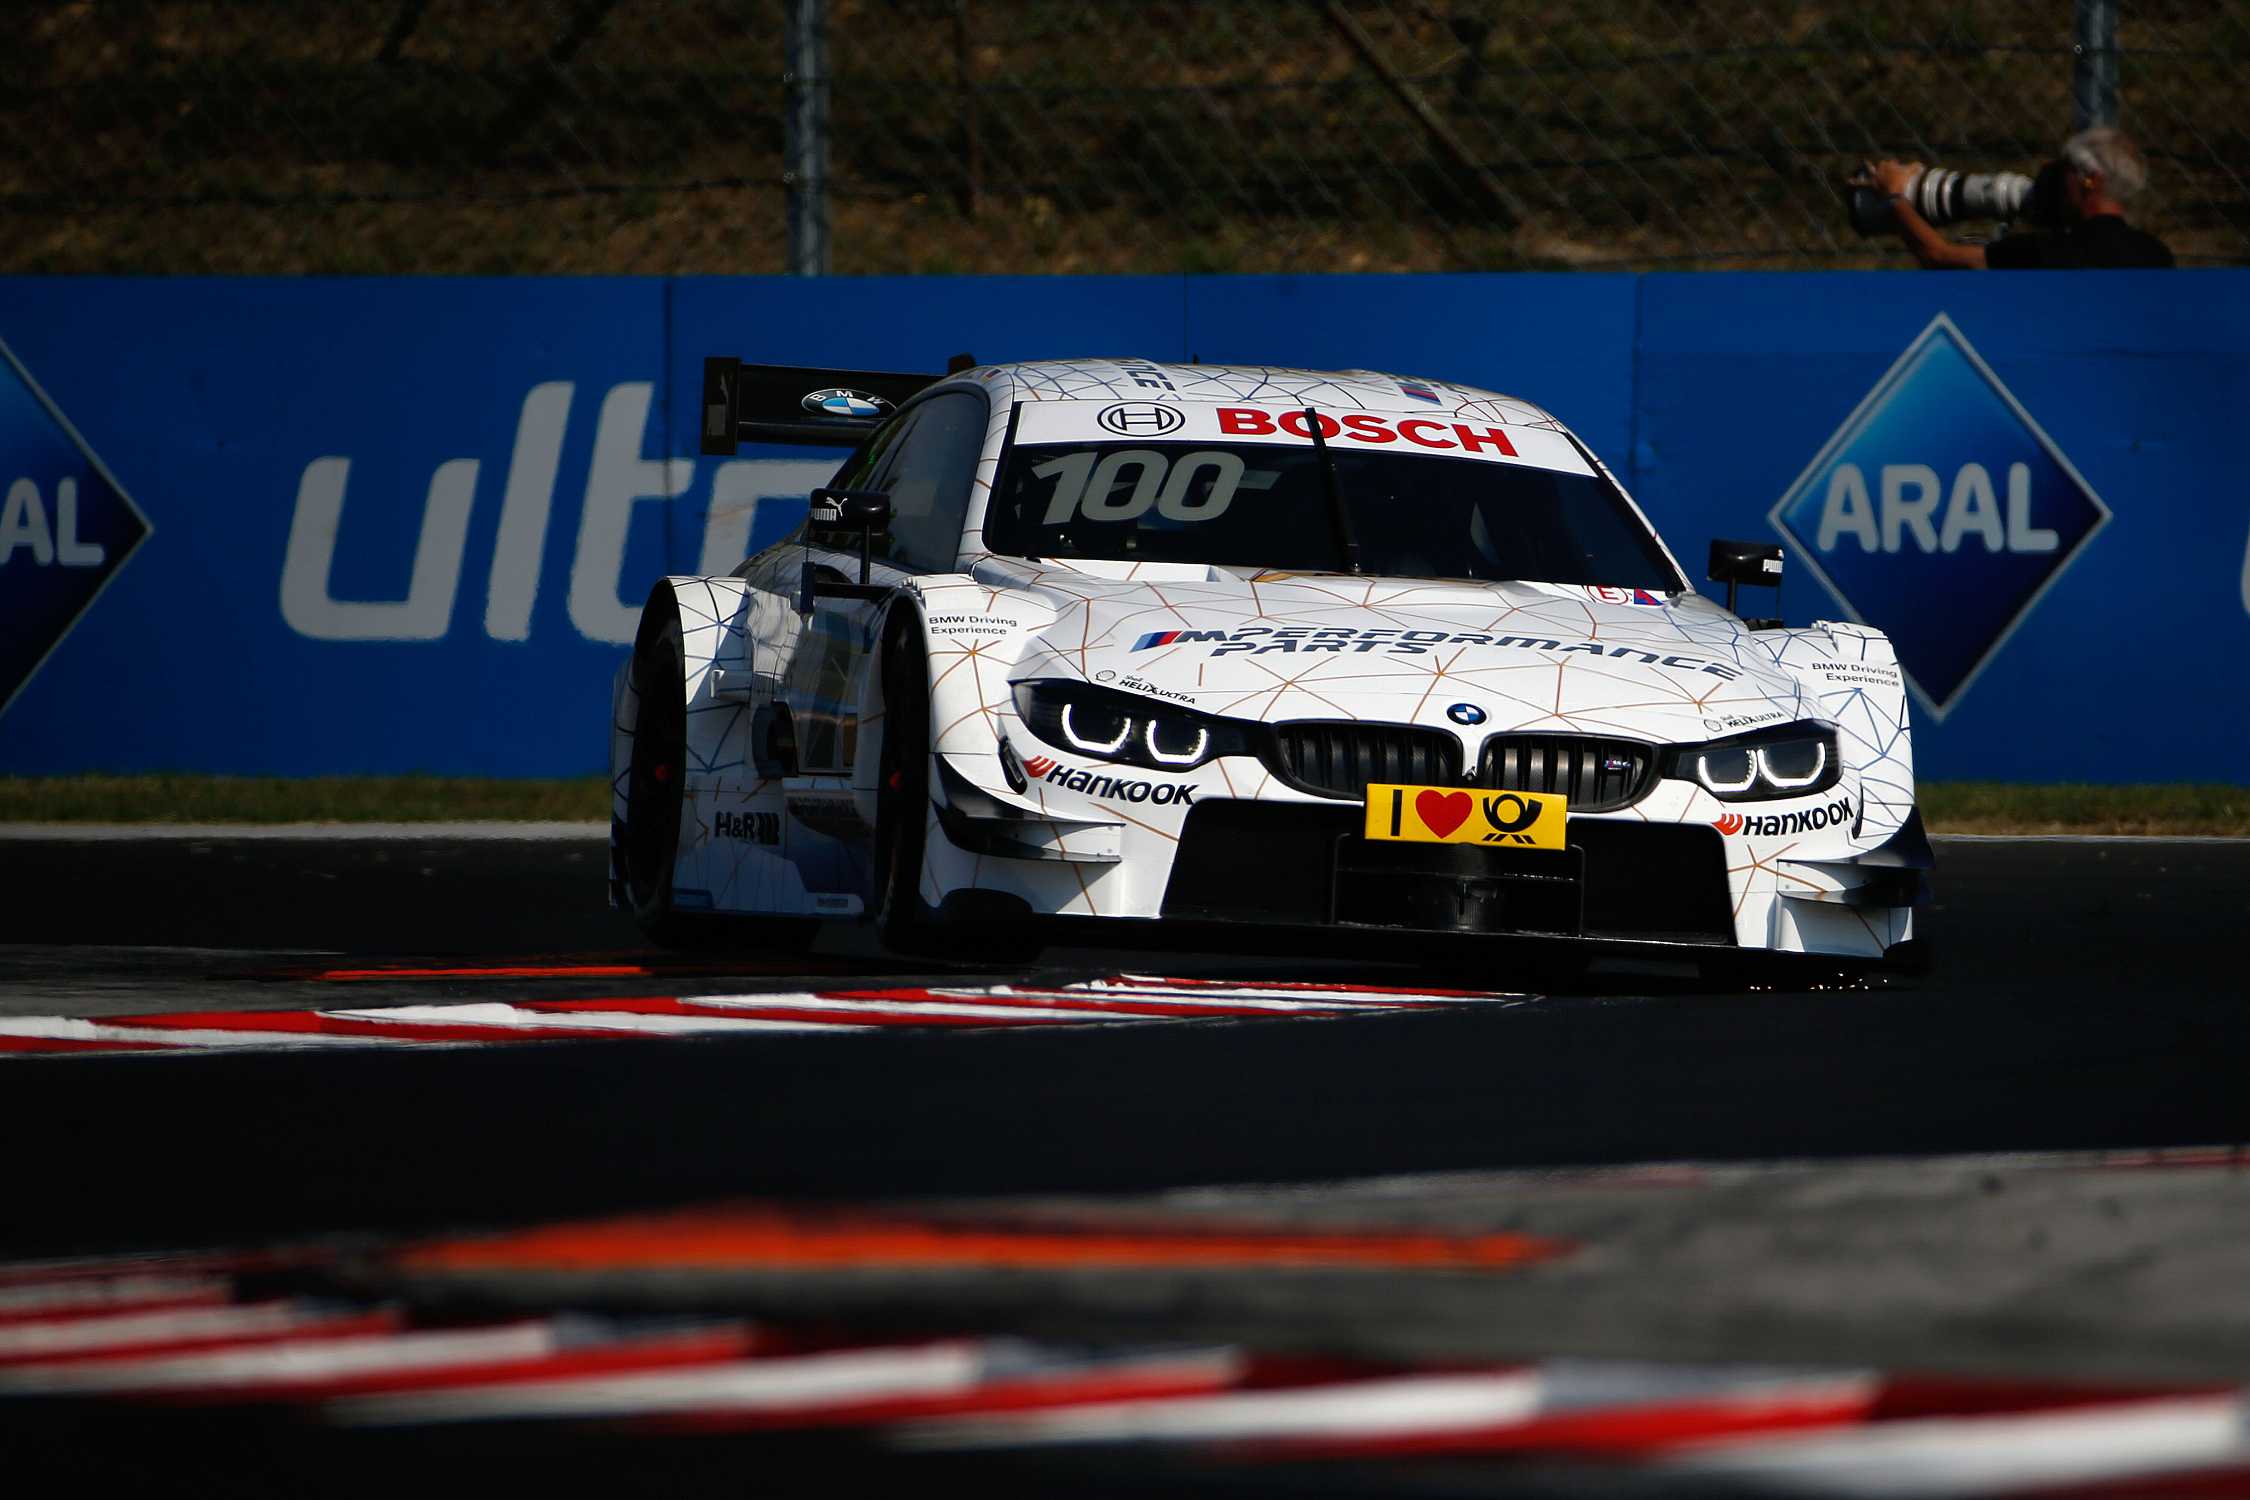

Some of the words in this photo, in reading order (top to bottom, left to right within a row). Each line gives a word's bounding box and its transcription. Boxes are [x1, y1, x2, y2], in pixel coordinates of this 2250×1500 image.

[809, 390, 884, 404] BMW
[1216, 407, 1519, 457] BOSCH
[1032, 450, 1246, 525] 100
[0, 478, 104, 566] AL
[281, 381, 853, 643] ultr
[1817, 462, 2059, 553] ARAL
[929, 616, 965, 624] BMW
[969, 616, 1017, 627] Driving
[931, 627, 1007, 635] Experience
[1210, 639, 1435, 657] PARTS
[1229, 627, 1743, 681] PERFORMANCE
[1826, 673, 1899, 686] Experience
[1851, 664, 1898, 678] Driving
[714, 811, 757, 839] H&R
[1391, 789, 1403, 836] I
